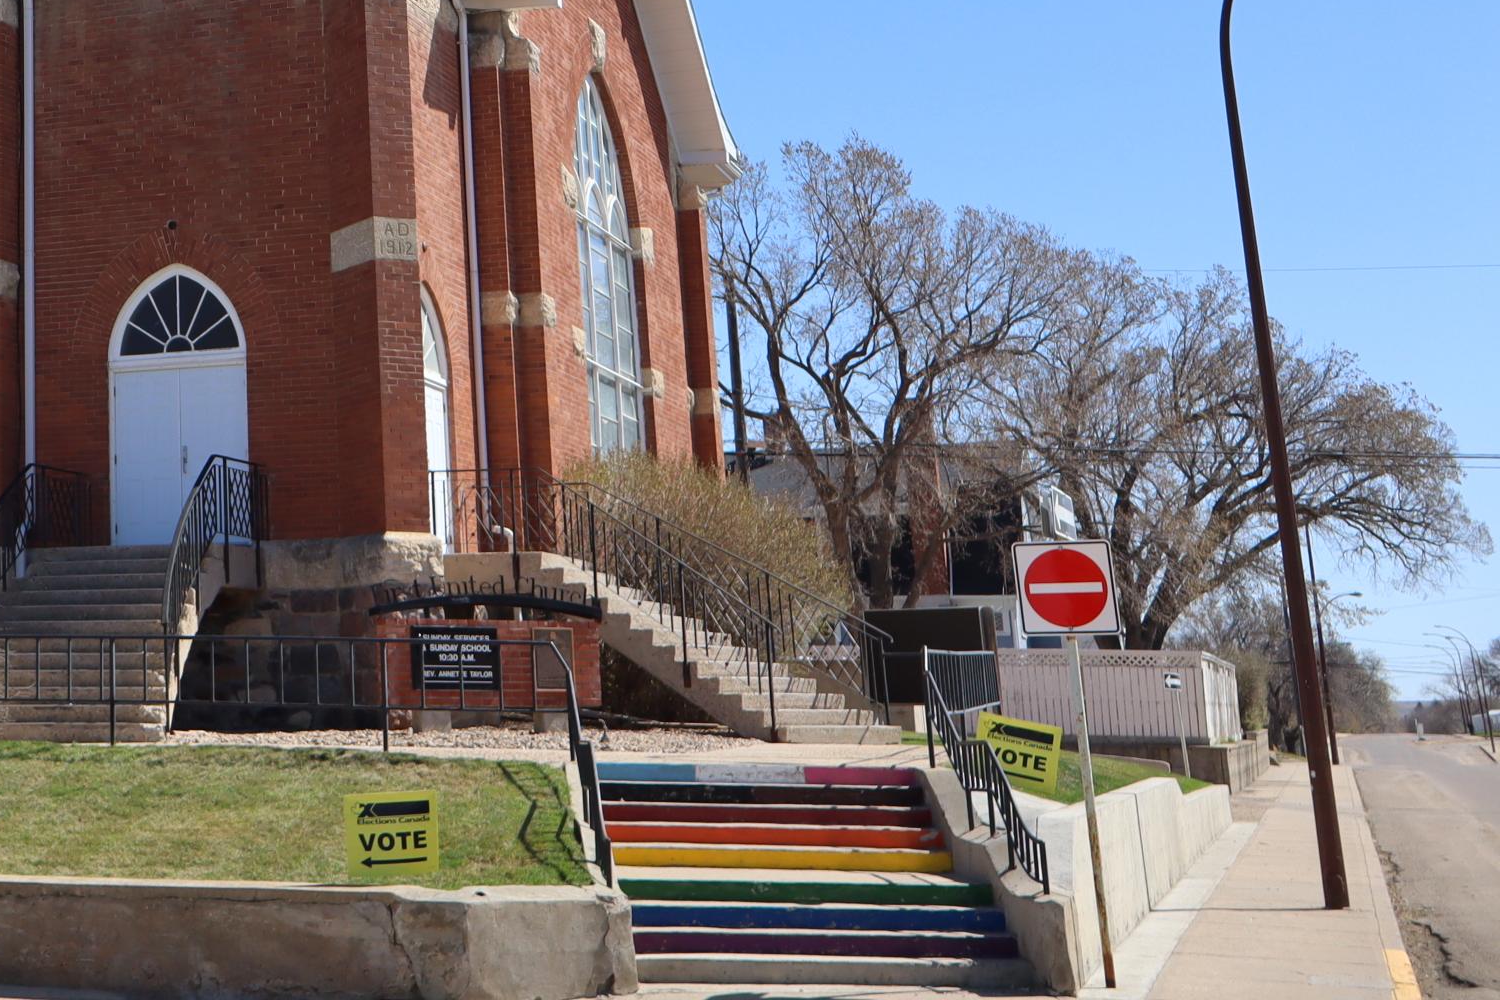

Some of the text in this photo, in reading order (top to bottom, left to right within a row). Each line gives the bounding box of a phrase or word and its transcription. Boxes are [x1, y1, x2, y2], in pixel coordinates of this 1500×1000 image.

[380, 239, 414, 256] 1912
[429, 644, 459, 652] SUNDAY
[461, 644, 492, 652] SCHOOL
[439, 653, 459, 662] 10:30
[438, 670, 468, 678] ANNETE
[470, 670, 493, 678] TAYLOR
[986, 732, 1053, 752] Elections Canada
[357, 814, 430, 825] Elections Canada
[358, 830, 428, 852] VOTE
